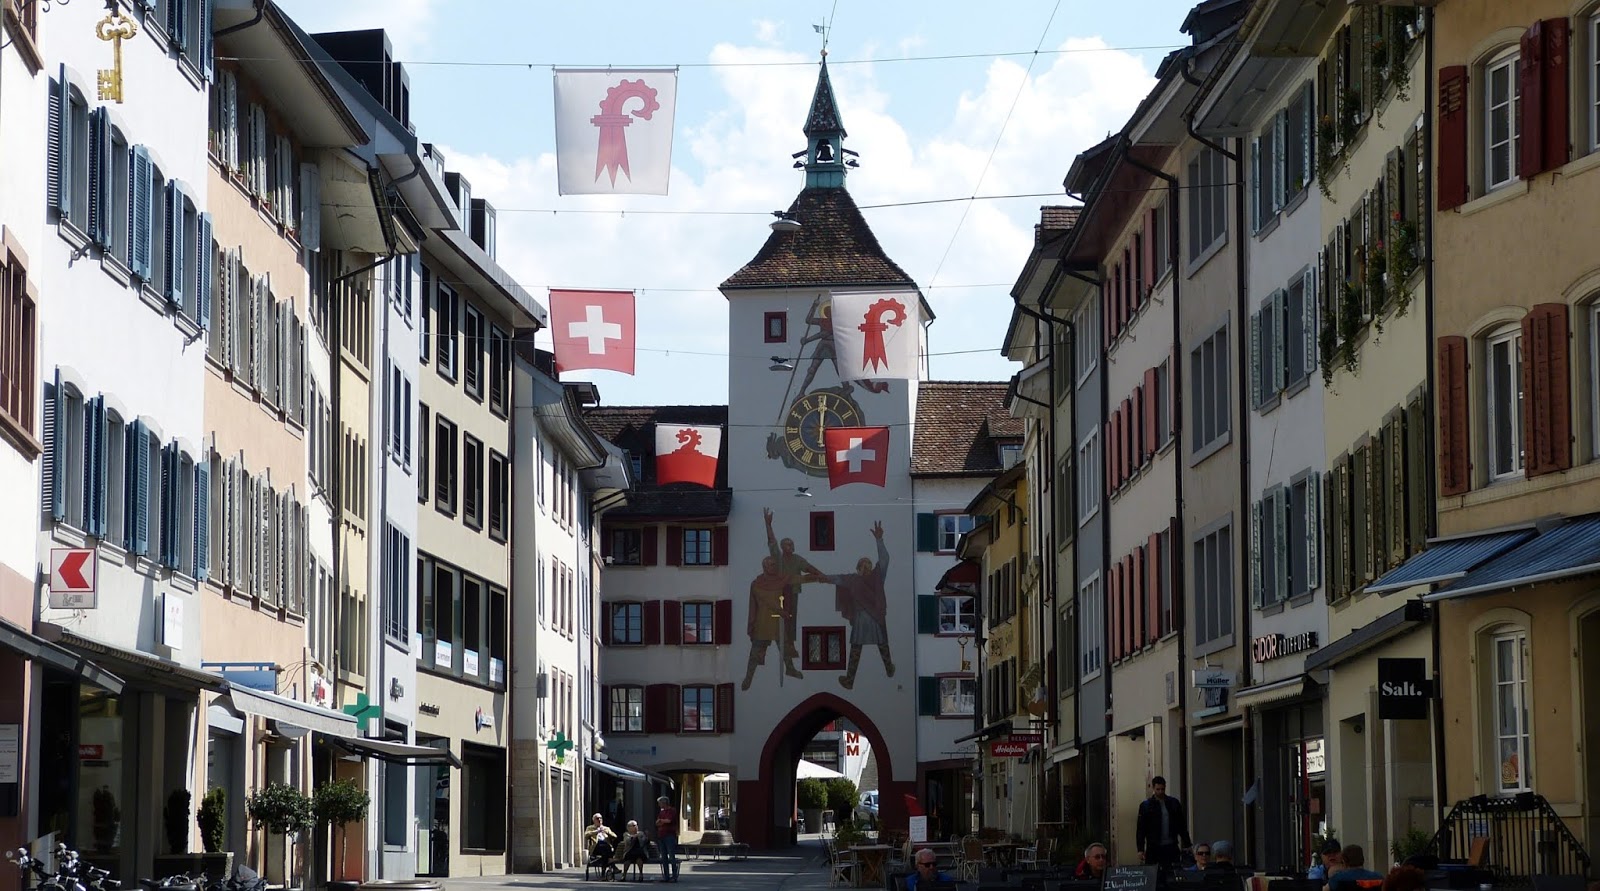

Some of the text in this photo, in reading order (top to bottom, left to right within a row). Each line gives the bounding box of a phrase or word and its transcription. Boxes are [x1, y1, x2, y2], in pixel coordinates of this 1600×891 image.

[1279, 632, 1310, 656] COIFFURE
[1382, 681, 1423, 697] Salt.
[995, 745, 1026, 755] Hotelplan
